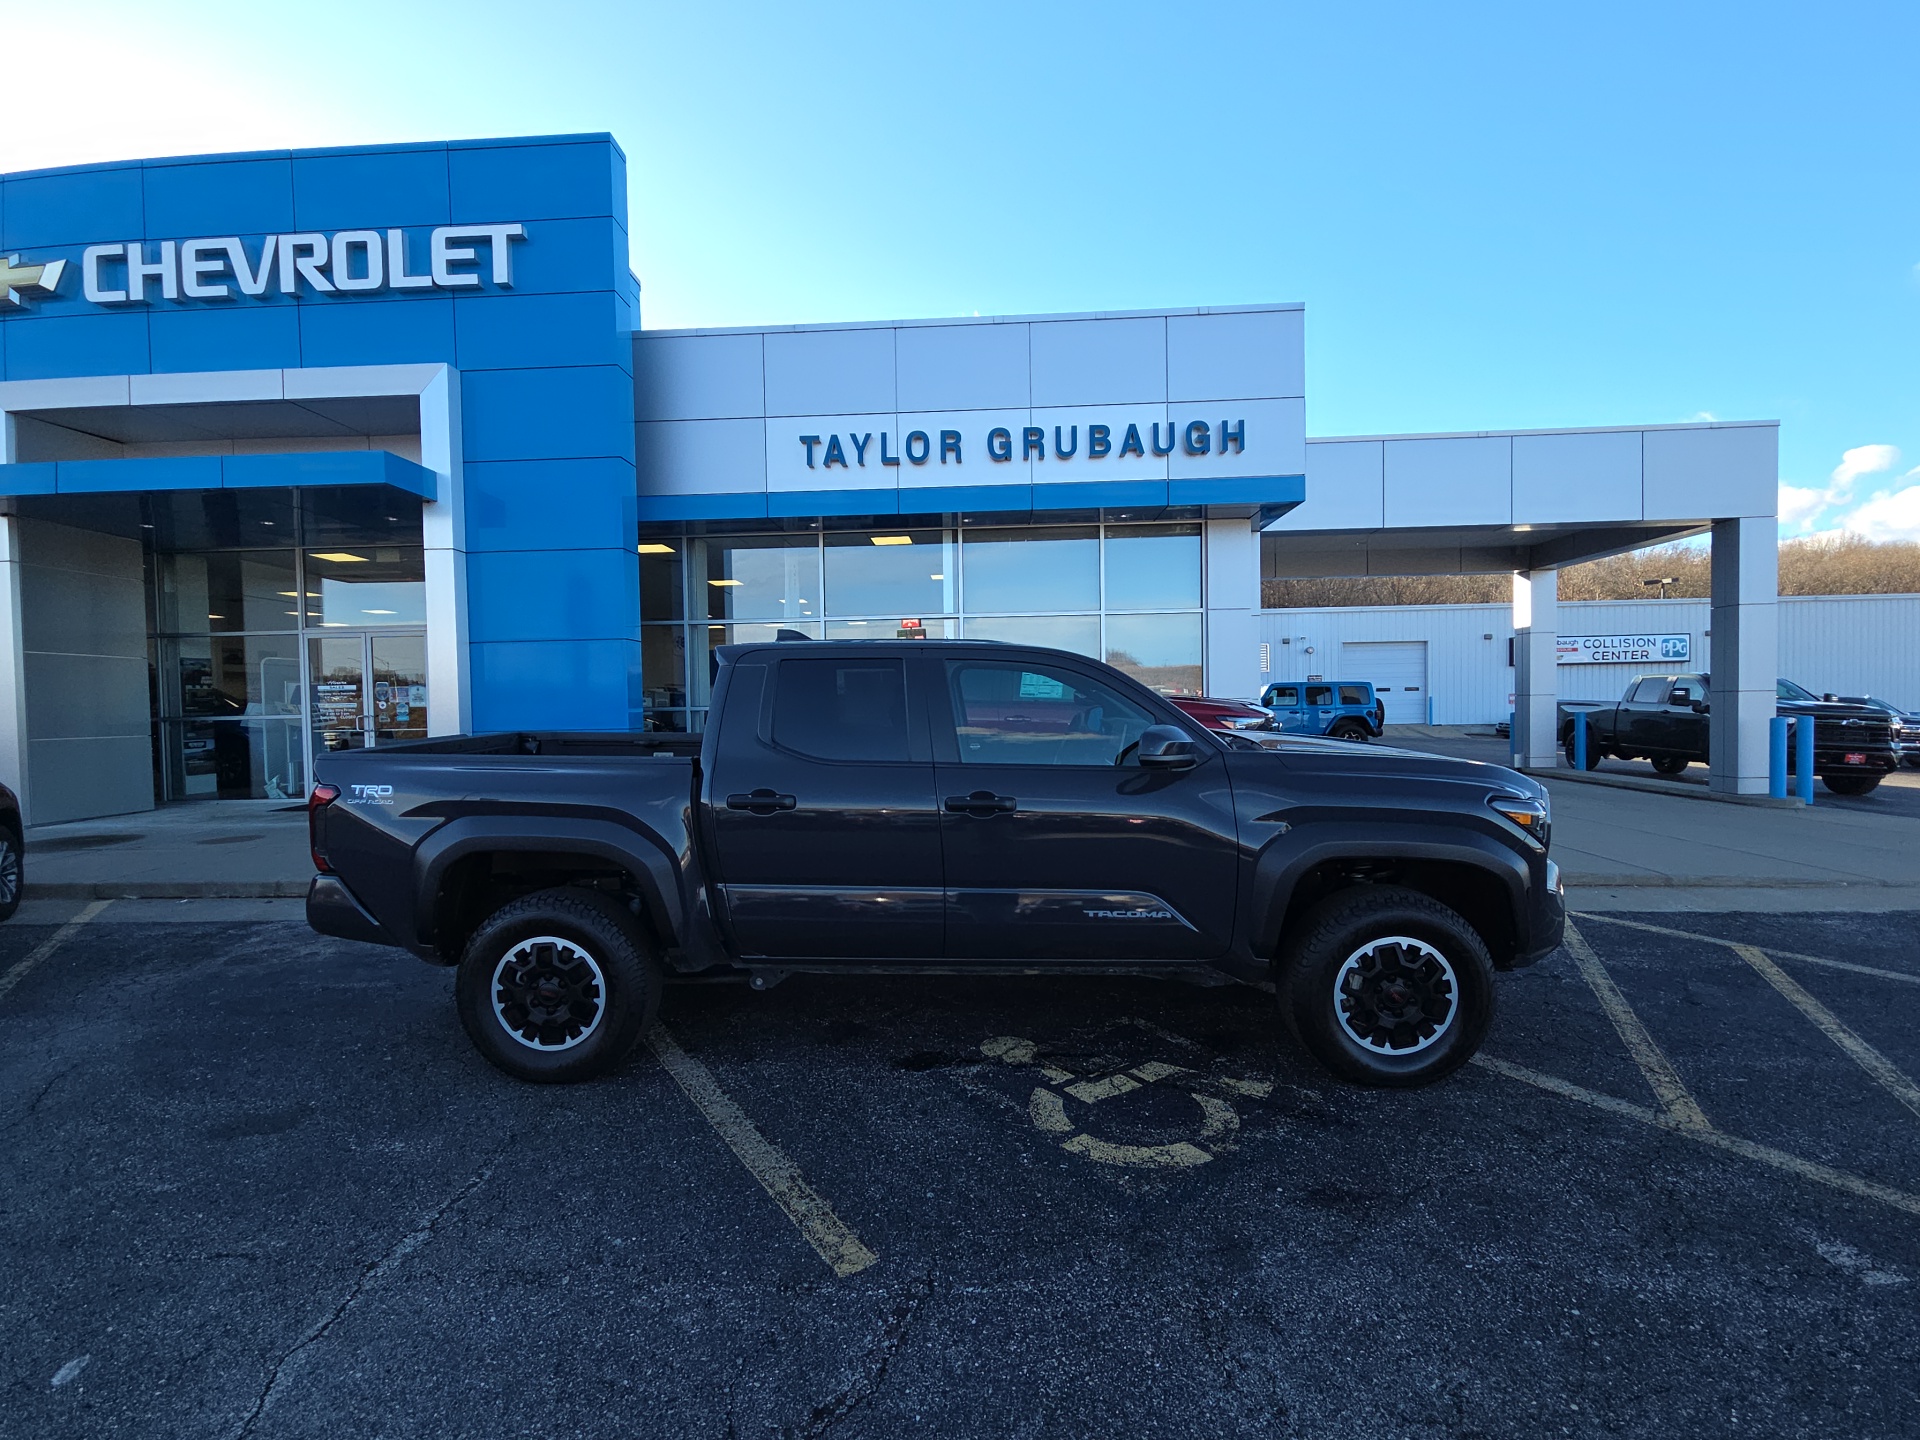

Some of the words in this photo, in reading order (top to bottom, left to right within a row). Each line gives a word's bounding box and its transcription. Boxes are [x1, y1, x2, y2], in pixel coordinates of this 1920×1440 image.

[83, 223, 525, 304] CHEVROLET
[799, 429, 963, 469] TAYLOR
[986, 419, 1246, 462] GRUBAUGH
[1583, 638, 1657, 649] COLLISION
[1592, 650, 1650, 661] CENTER
[351, 784, 393, 798] TRD
[1083, 909, 1172, 918] TACOMA
